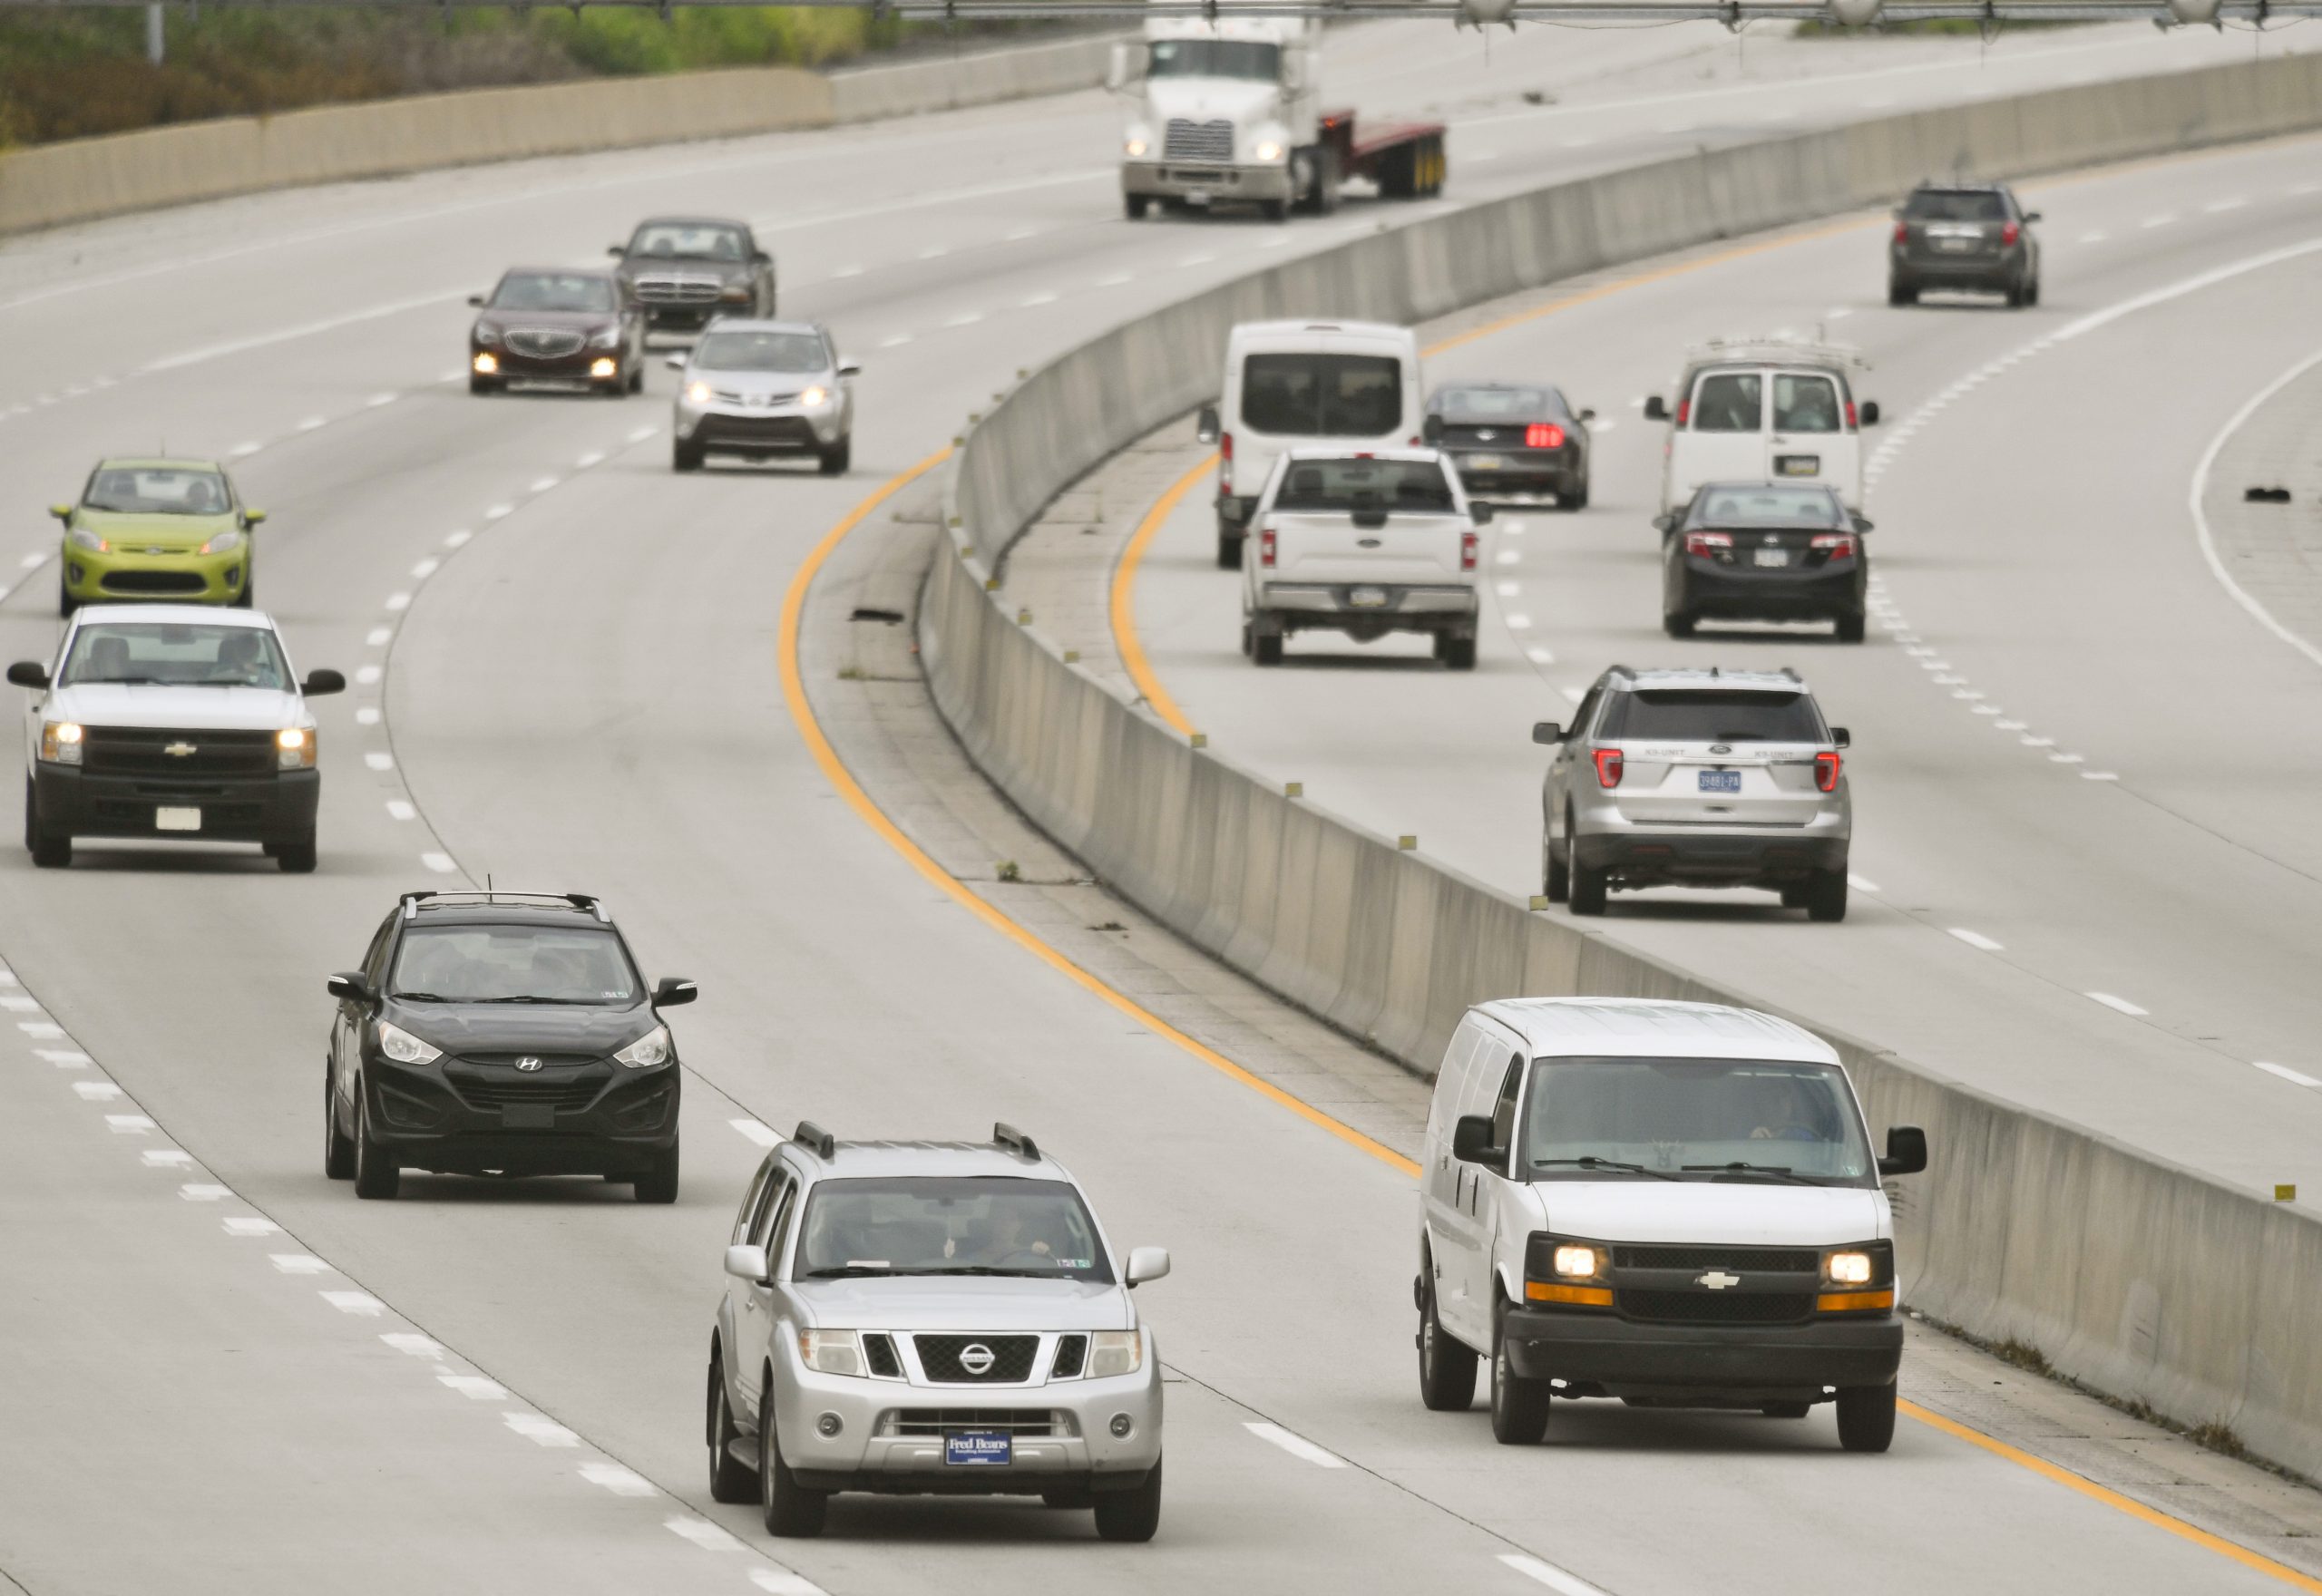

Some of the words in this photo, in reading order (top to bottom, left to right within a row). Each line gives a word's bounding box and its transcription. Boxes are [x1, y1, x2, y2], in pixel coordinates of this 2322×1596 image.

[1644, 748, 1685, 756] K9-UNIT
[1754, 750, 1793, 759] K9-UNIT
[949, 1437, 973, 1449] Fred
[976, 1438, 1008, 1449] Beans
